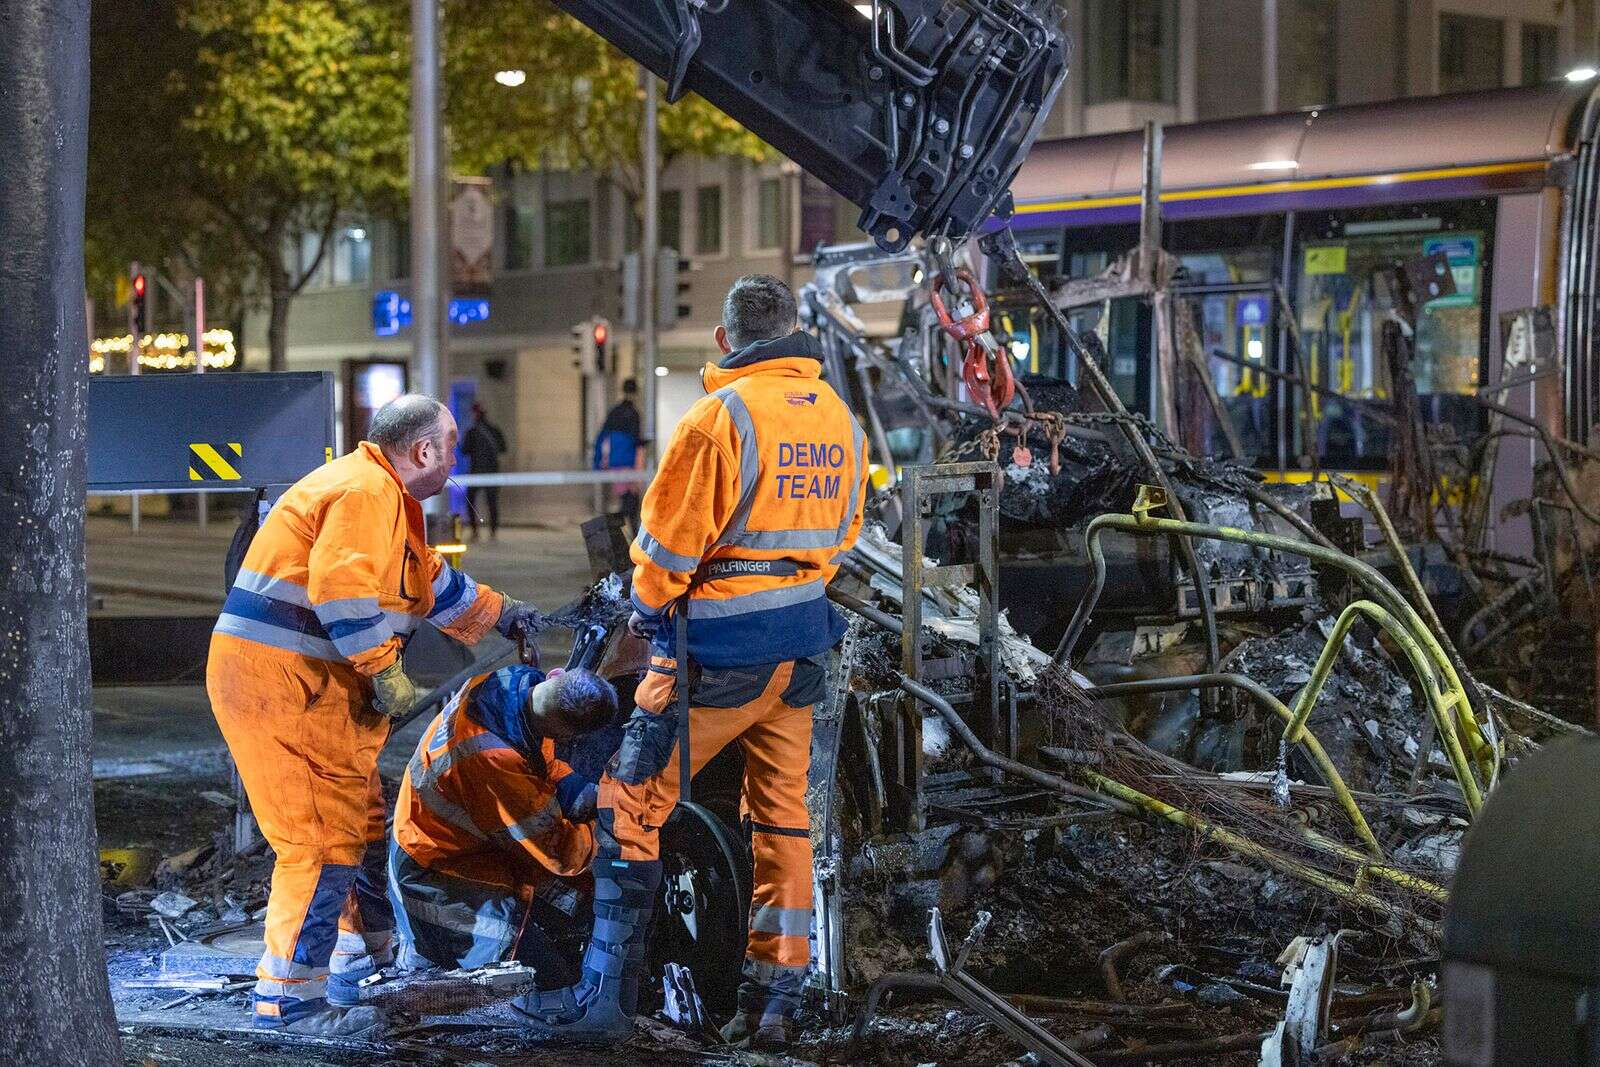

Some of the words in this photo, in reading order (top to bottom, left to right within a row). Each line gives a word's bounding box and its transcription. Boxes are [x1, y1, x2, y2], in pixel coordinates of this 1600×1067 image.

[779, 443, 844, 468] DEMO
[776, 475, 840, 499] TEAM
[709, 560, 770, 575] PALFINGER
